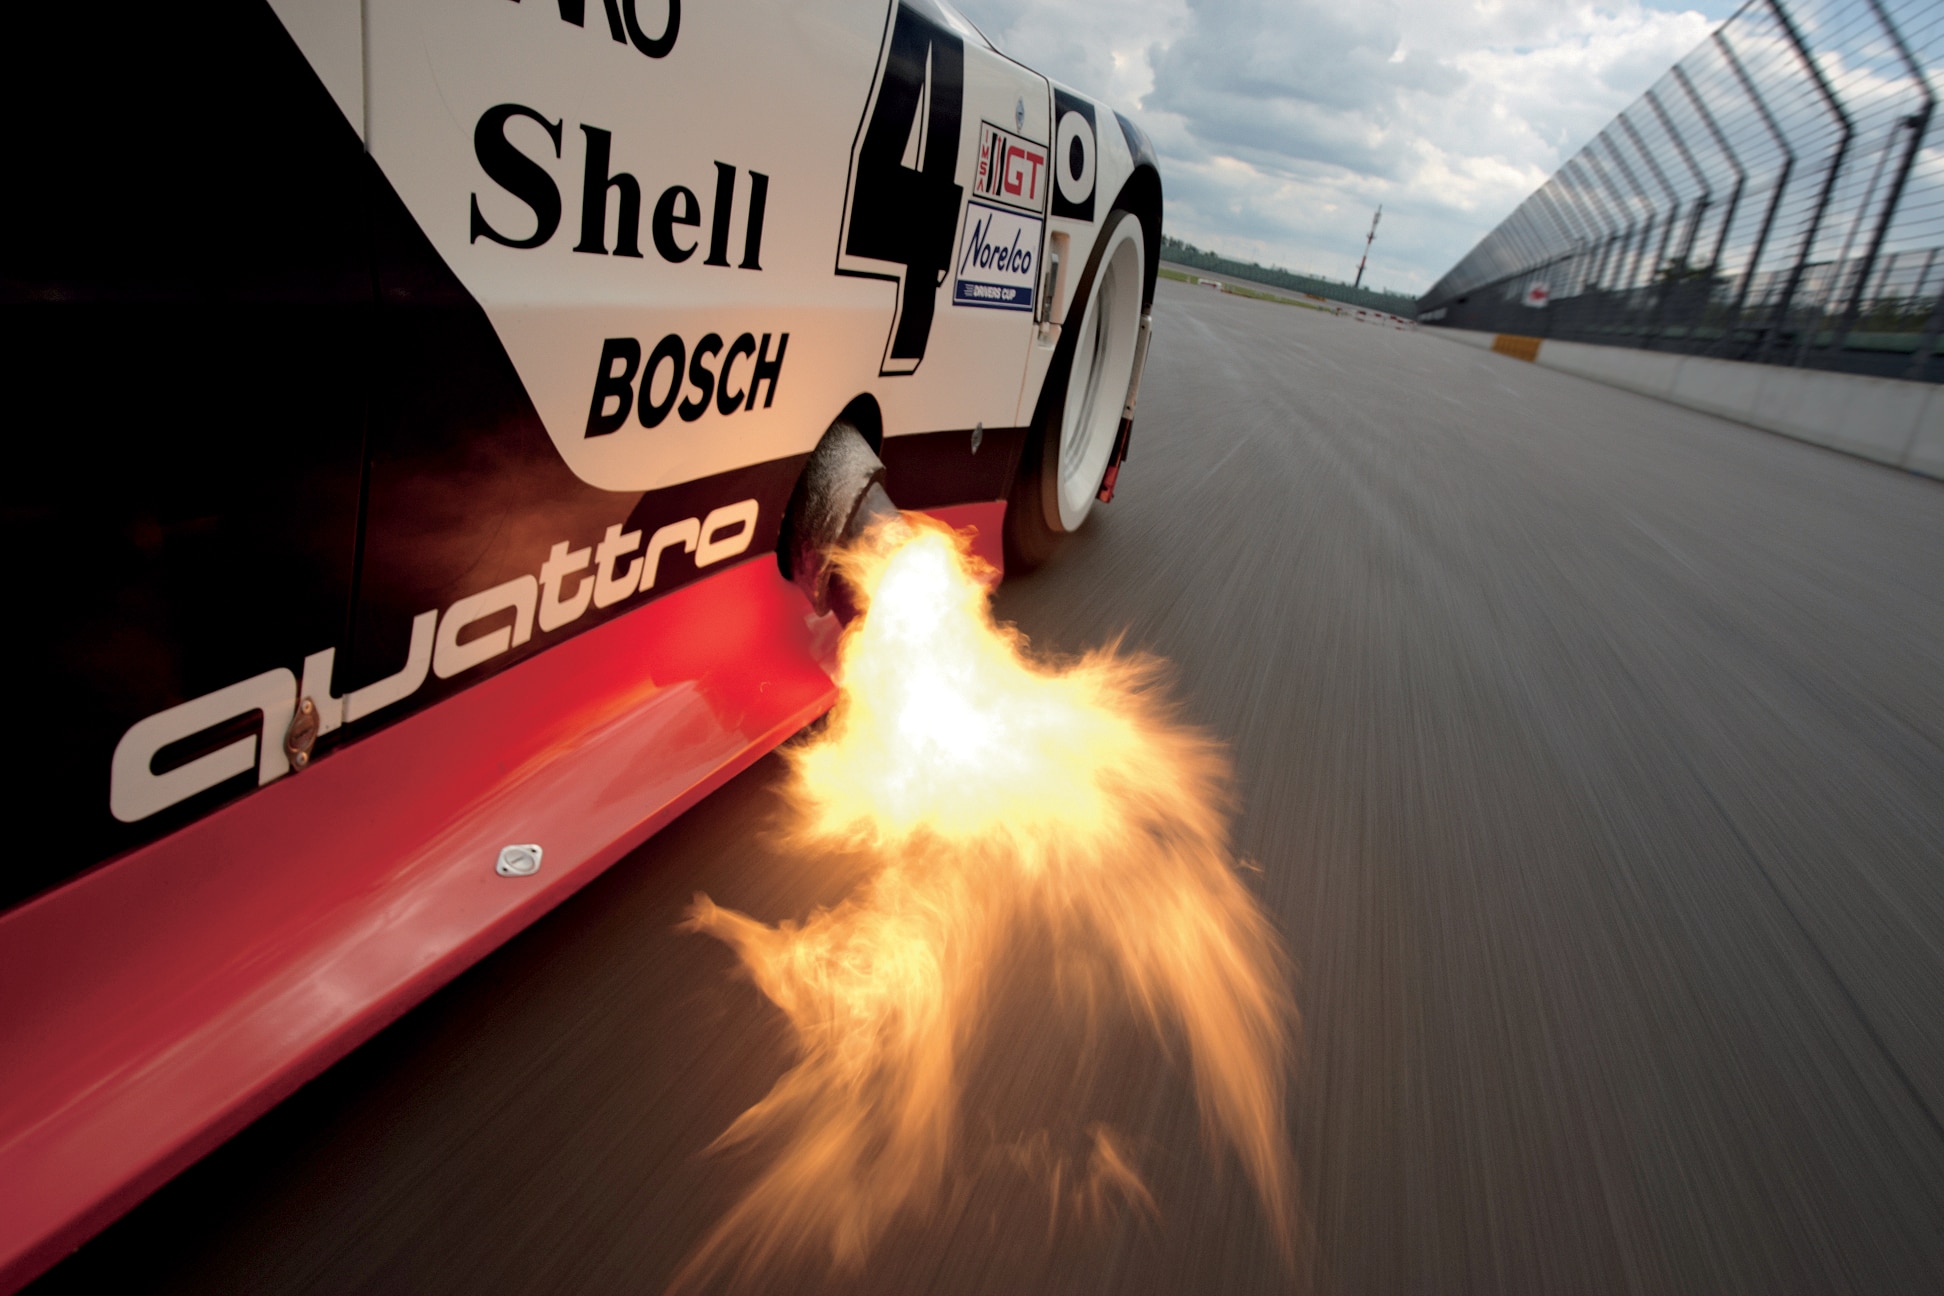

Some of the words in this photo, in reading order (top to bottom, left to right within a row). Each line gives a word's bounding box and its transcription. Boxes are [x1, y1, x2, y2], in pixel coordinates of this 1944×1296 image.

[470, 103, 769, 271] Shell
[834, 0, 964, 377] 4
[1004, 145, 1044, 200] GT
[960, 213, 1032, 276] Norelco
[973, 284, 1001, 300] DRIVERS
[1001, 287, 1017, 301] CUP
[584, 333, 789, 439] BOSCH
[109, 498, 759, 823] quattro
